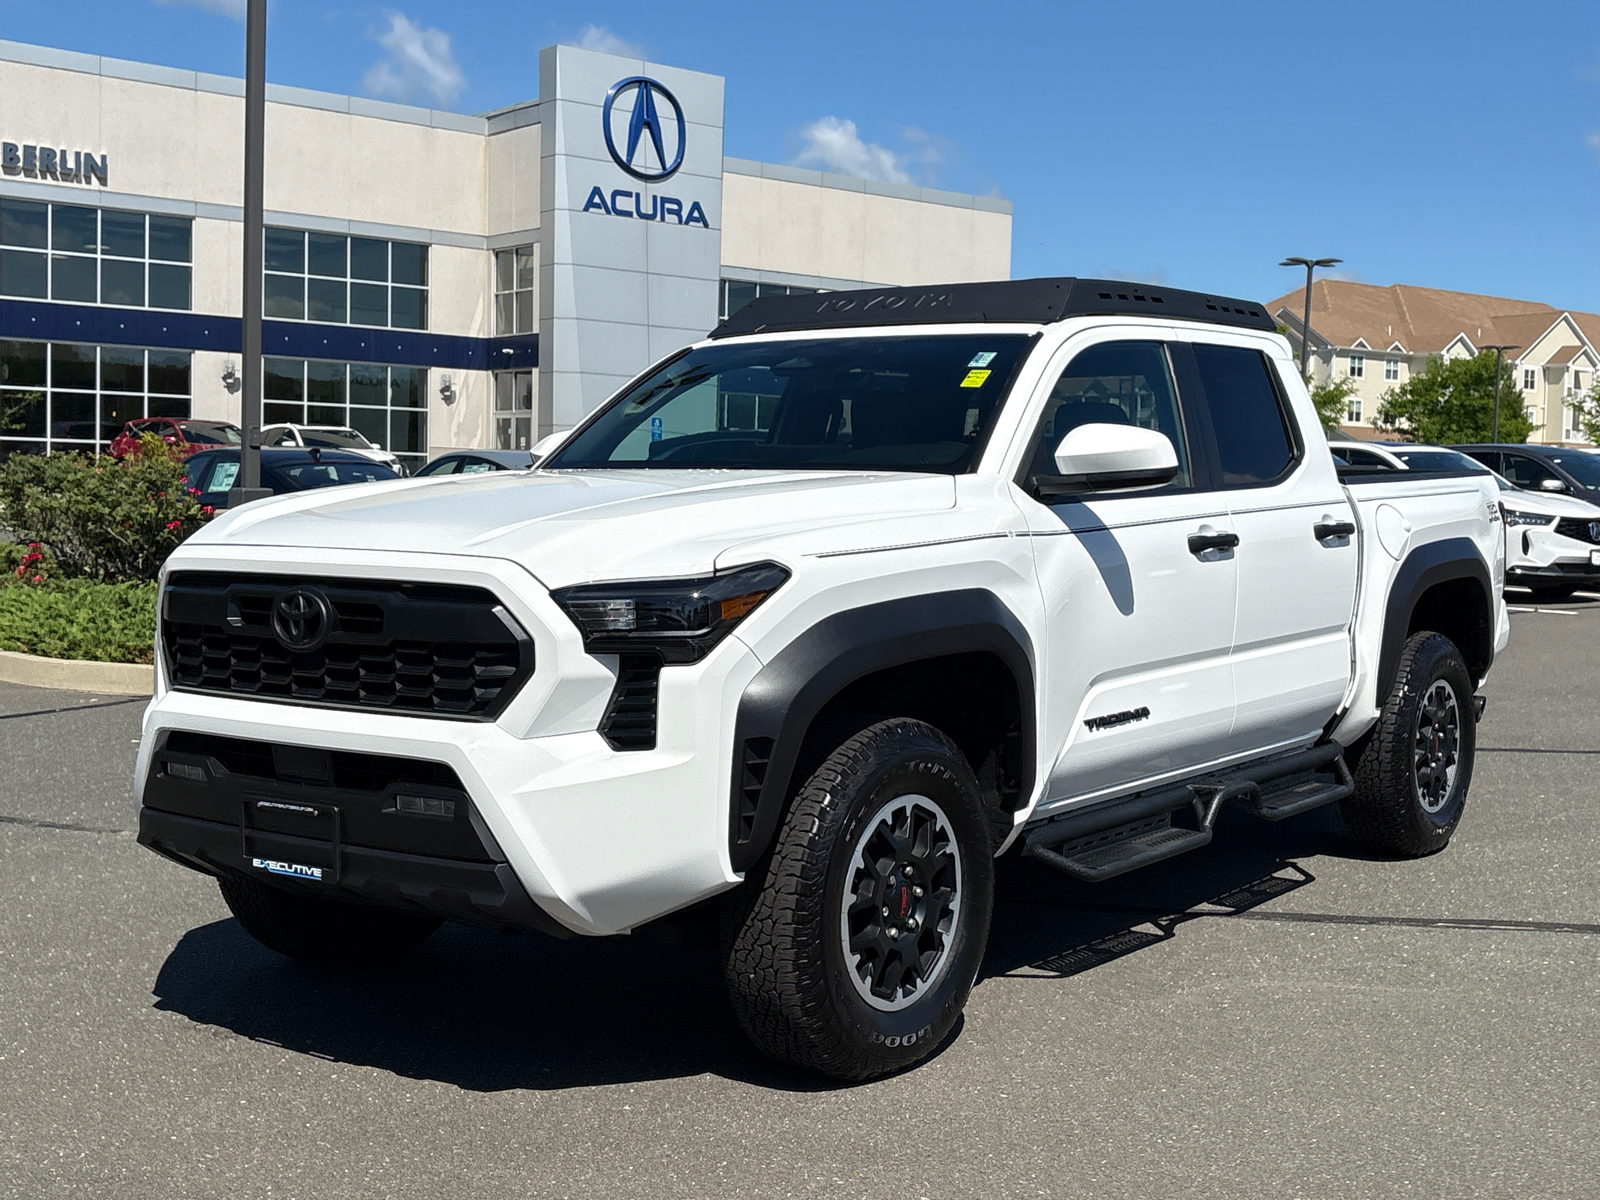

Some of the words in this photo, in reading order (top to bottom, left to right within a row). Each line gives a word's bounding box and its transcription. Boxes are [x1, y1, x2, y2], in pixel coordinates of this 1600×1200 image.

[2, 141, 107, 180] BERLIN
[582, 186, 709, 229] ACURA
[814, 294, 954, 314] TOYOTA
[1083, 706, 1150, 731] TACOMA
[252, 858, 322, 878] EXECUTIVE
